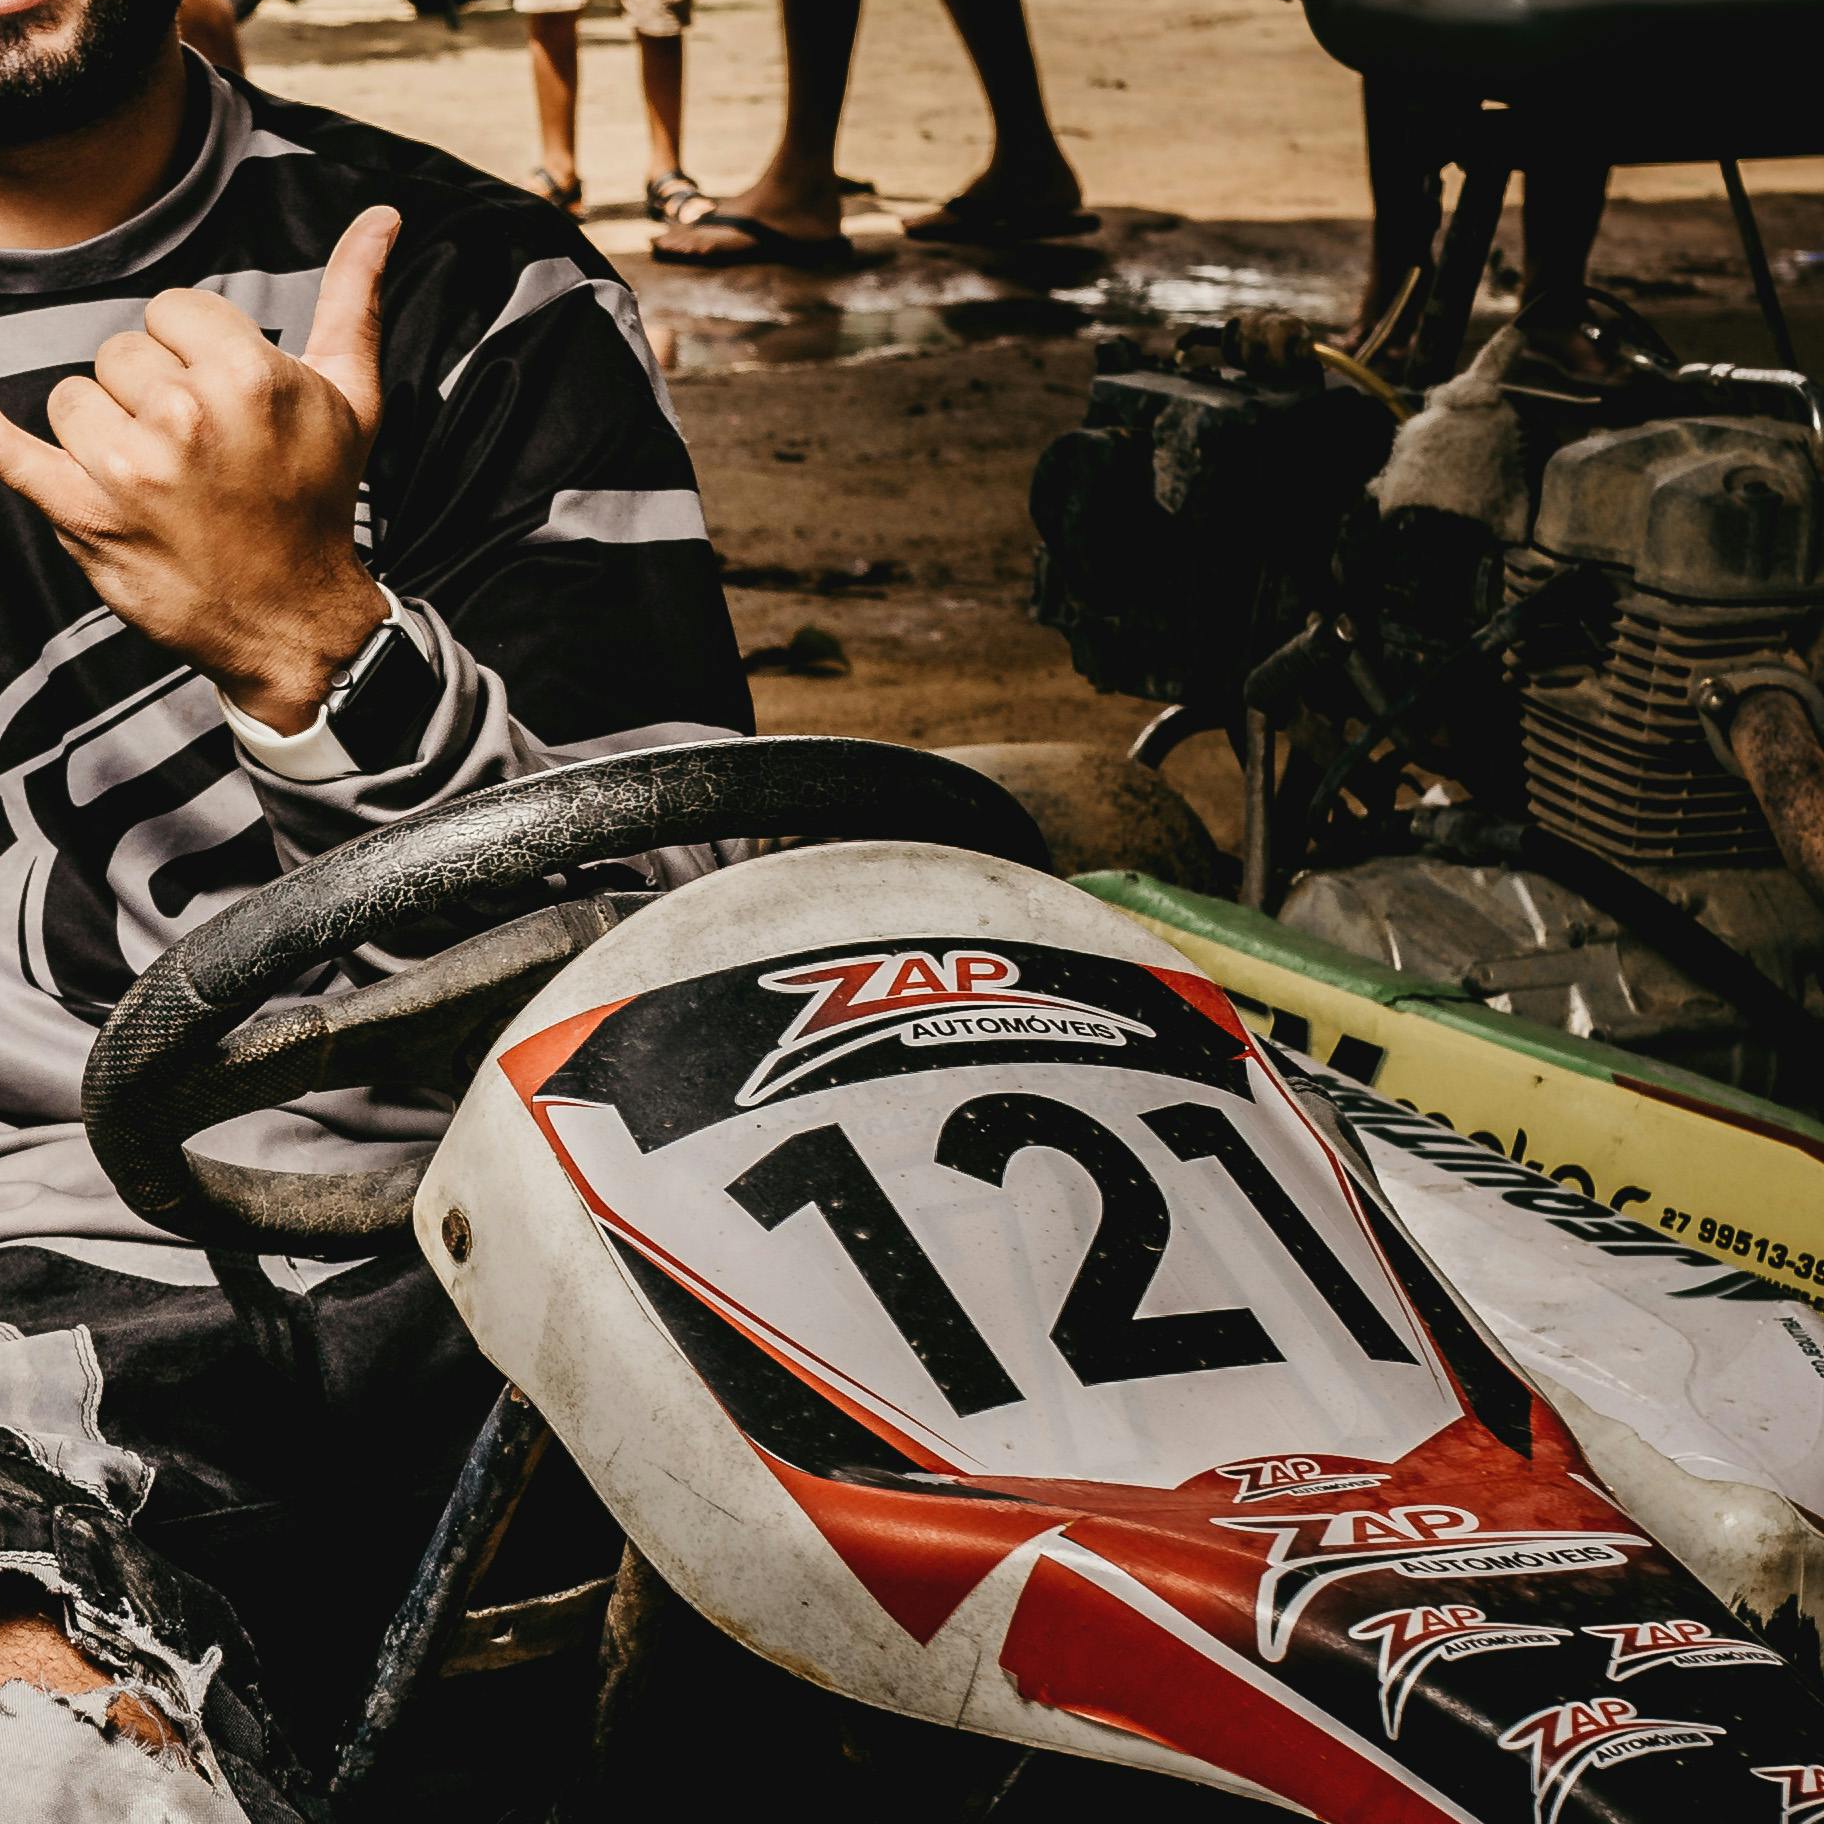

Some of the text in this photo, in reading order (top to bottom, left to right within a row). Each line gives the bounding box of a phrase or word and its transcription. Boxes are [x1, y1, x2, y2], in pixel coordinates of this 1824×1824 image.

[772, 956, 1009, 1041] ZAP
[911, 1014, 1116, 1040] AUTOMÓVEIS
[1660, 1208, 1691, 1234] 27
[723, 1091, 1421, 1418] 121
[1222, 1459, 1320, 1494] ZAP
[1228, 1510, 1469, 1562] ZAP
[1399, 1545, 1614, 1574] AUTOMÓVEIS
[1355, 1607, 1479, 1671] ZAP
[1445, 1632, 1552, 1656] AUTOMÓVEIS
[1587, 1622, 1706, 1657] ZAP
[1505, 1701, 1629, 1774] ZAP
